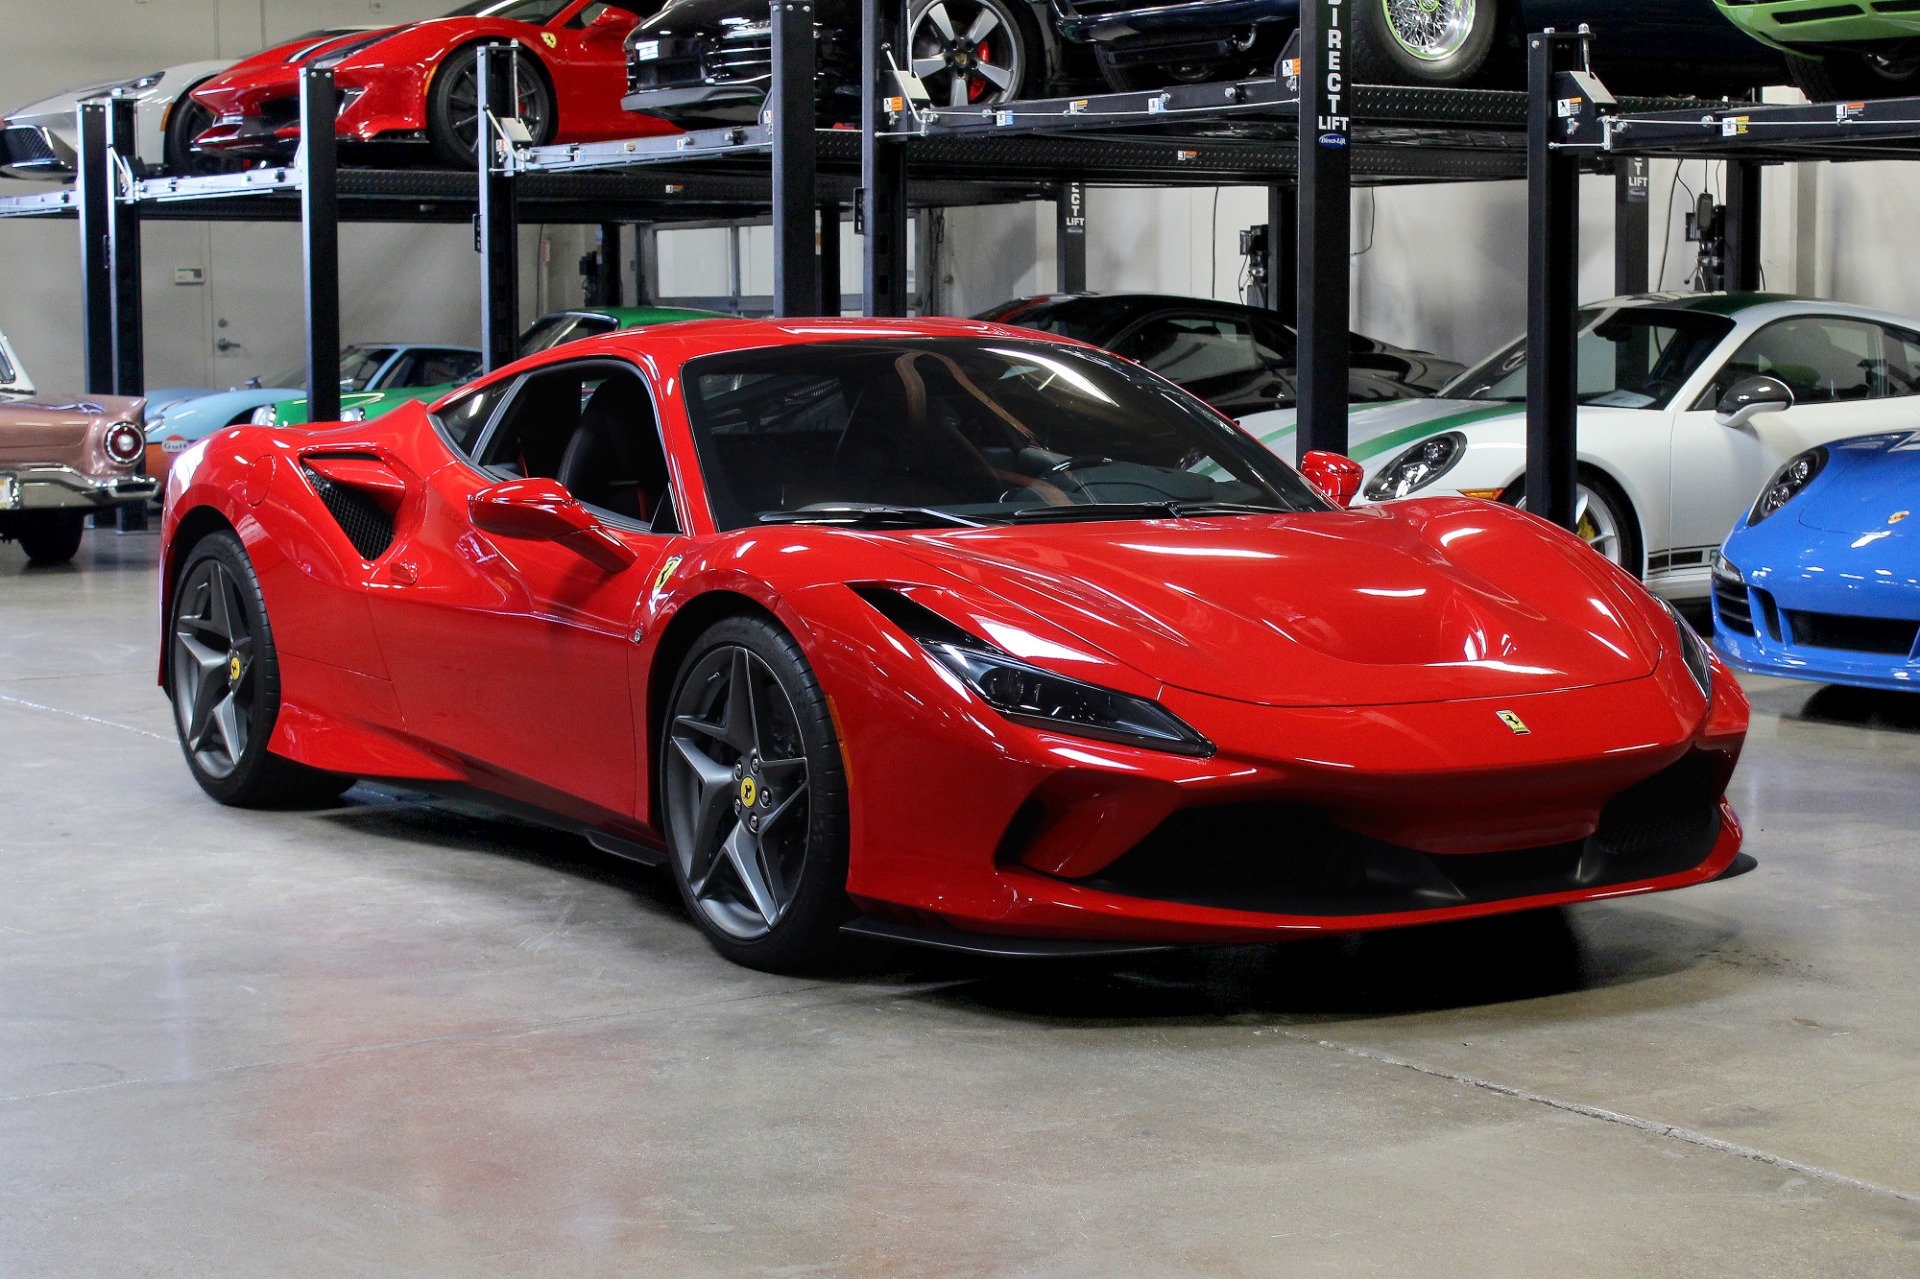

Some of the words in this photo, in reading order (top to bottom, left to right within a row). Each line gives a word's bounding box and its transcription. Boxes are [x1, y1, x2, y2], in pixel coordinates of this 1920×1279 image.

[1327, 0, 1342, 113] IRECT
[1318, 115, 1349, 130] LIFT
[1628, 176, 1648, 187] LIFT
[1066, 217, 1085, 226] LIFT
